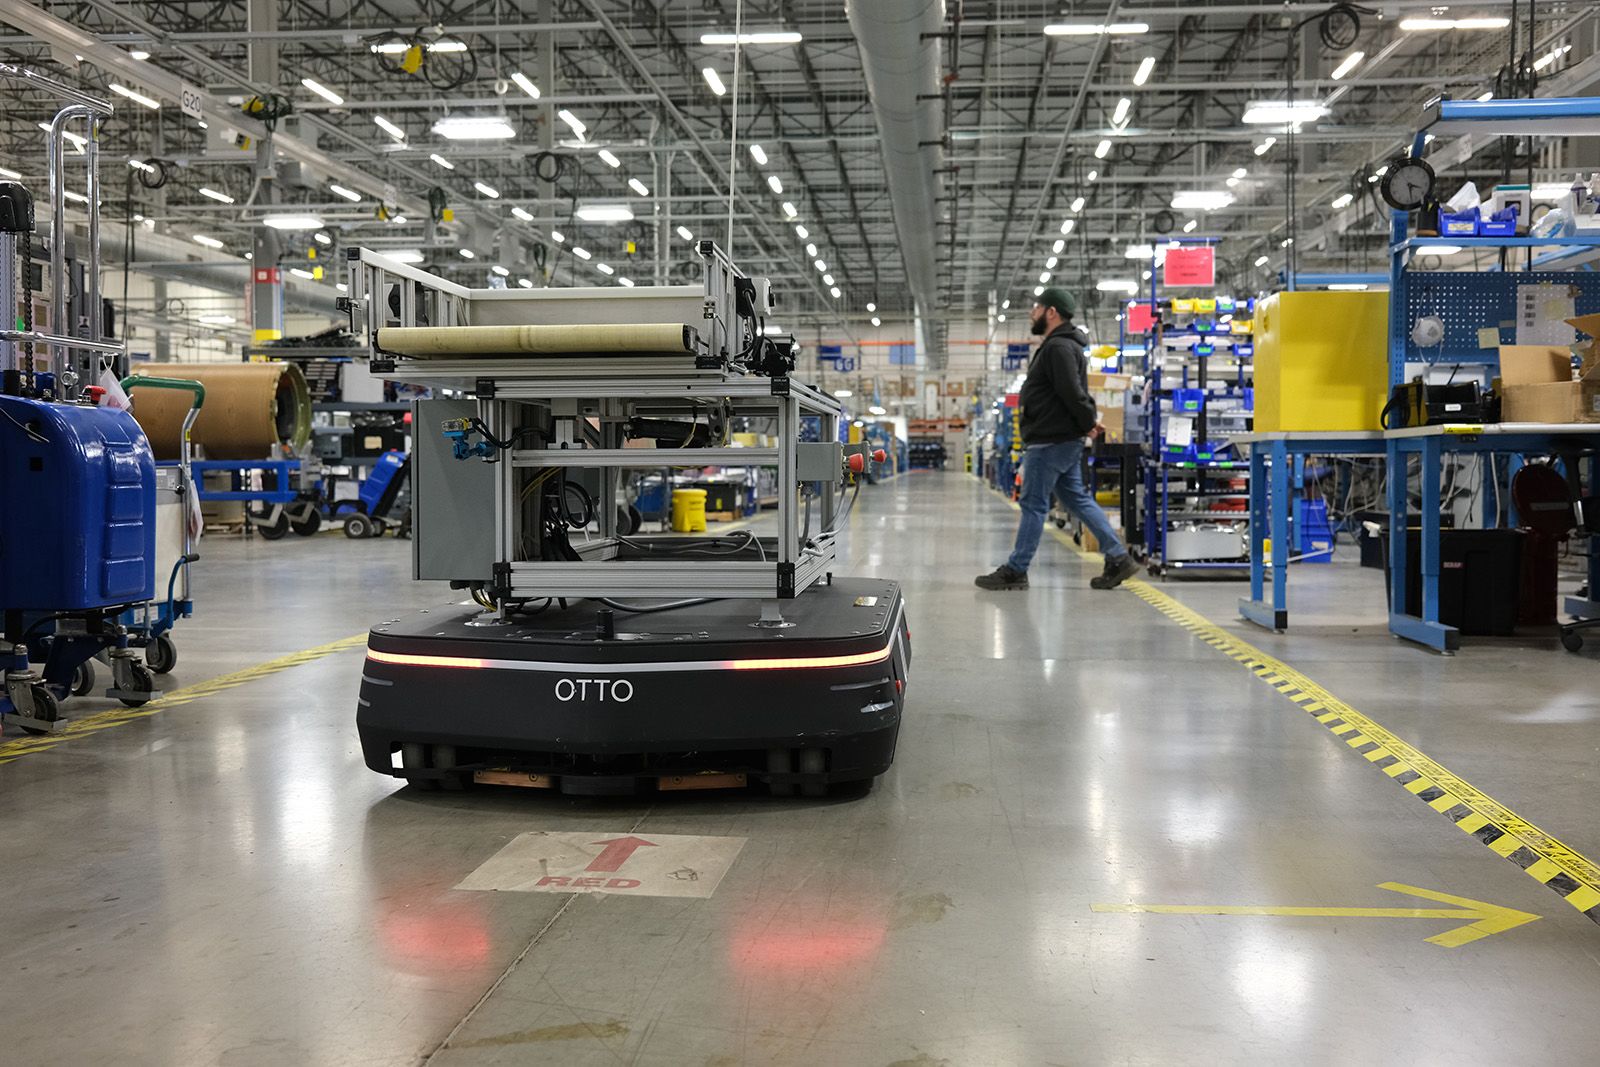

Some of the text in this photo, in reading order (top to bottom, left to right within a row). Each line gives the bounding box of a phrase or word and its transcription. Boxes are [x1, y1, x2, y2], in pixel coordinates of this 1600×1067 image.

[182, 90, 201, 113] G20
[555, 678, 633, 702] OTTO
[535, 876, 641, 889] RED
